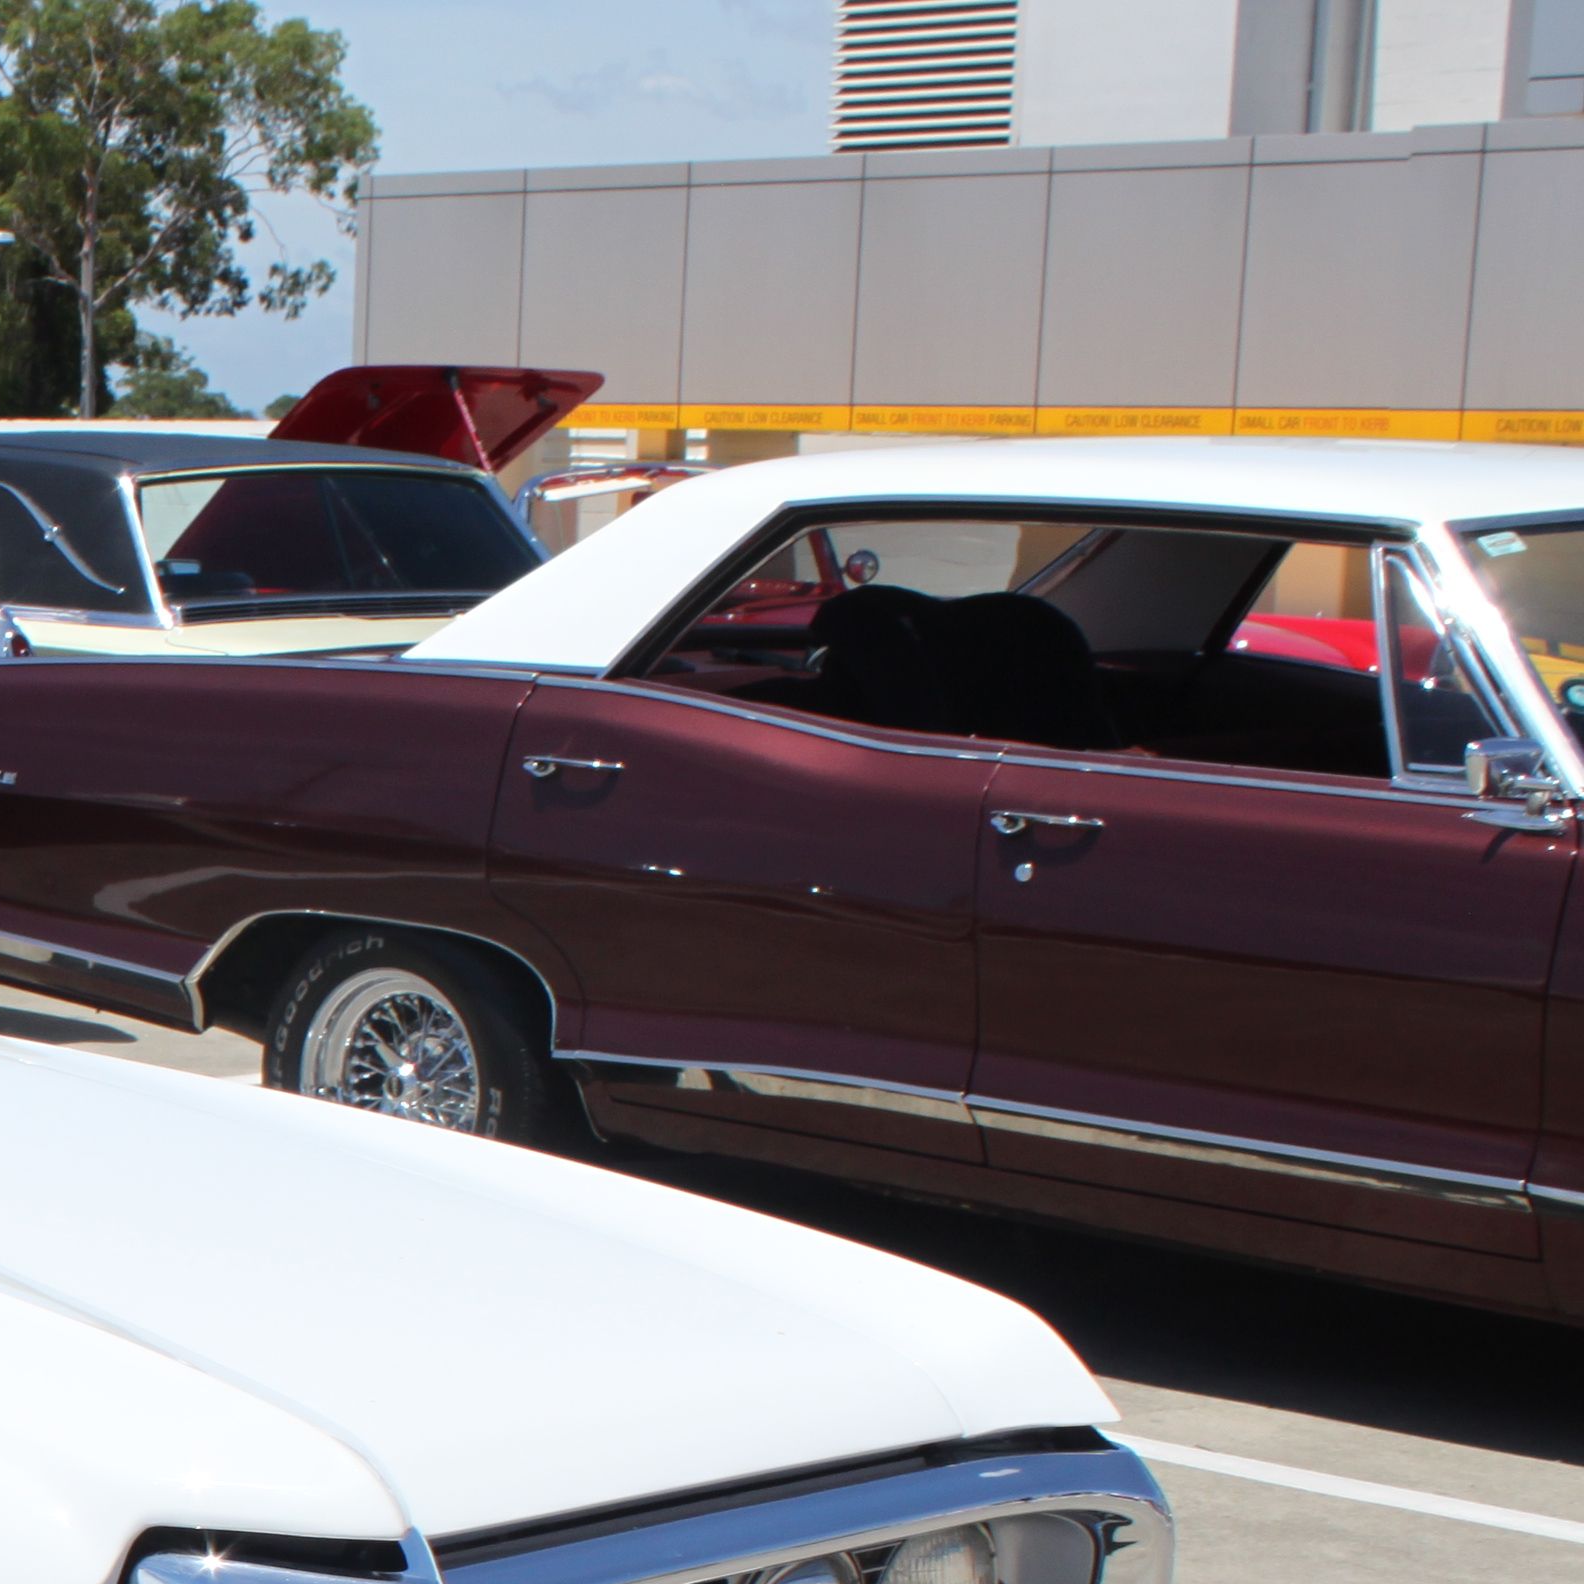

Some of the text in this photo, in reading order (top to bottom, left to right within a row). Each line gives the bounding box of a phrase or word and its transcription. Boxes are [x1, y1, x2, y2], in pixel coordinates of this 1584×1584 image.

[747, 411, 768, 424] LOW
[770, 411, 823, 425] CLEARANCE
[855, 412, 887, 425] SMALL
[889, 413, 909, 425] CAR
[988, 413, 1031, 427] PARKING
[1114, 415, 1138, 428] LOW
[1141, 415, 1201, 429] CLEARANCE
[1239, 415, 1275, 430] SMALL
[1278, 416, 1300, 430] CAR
